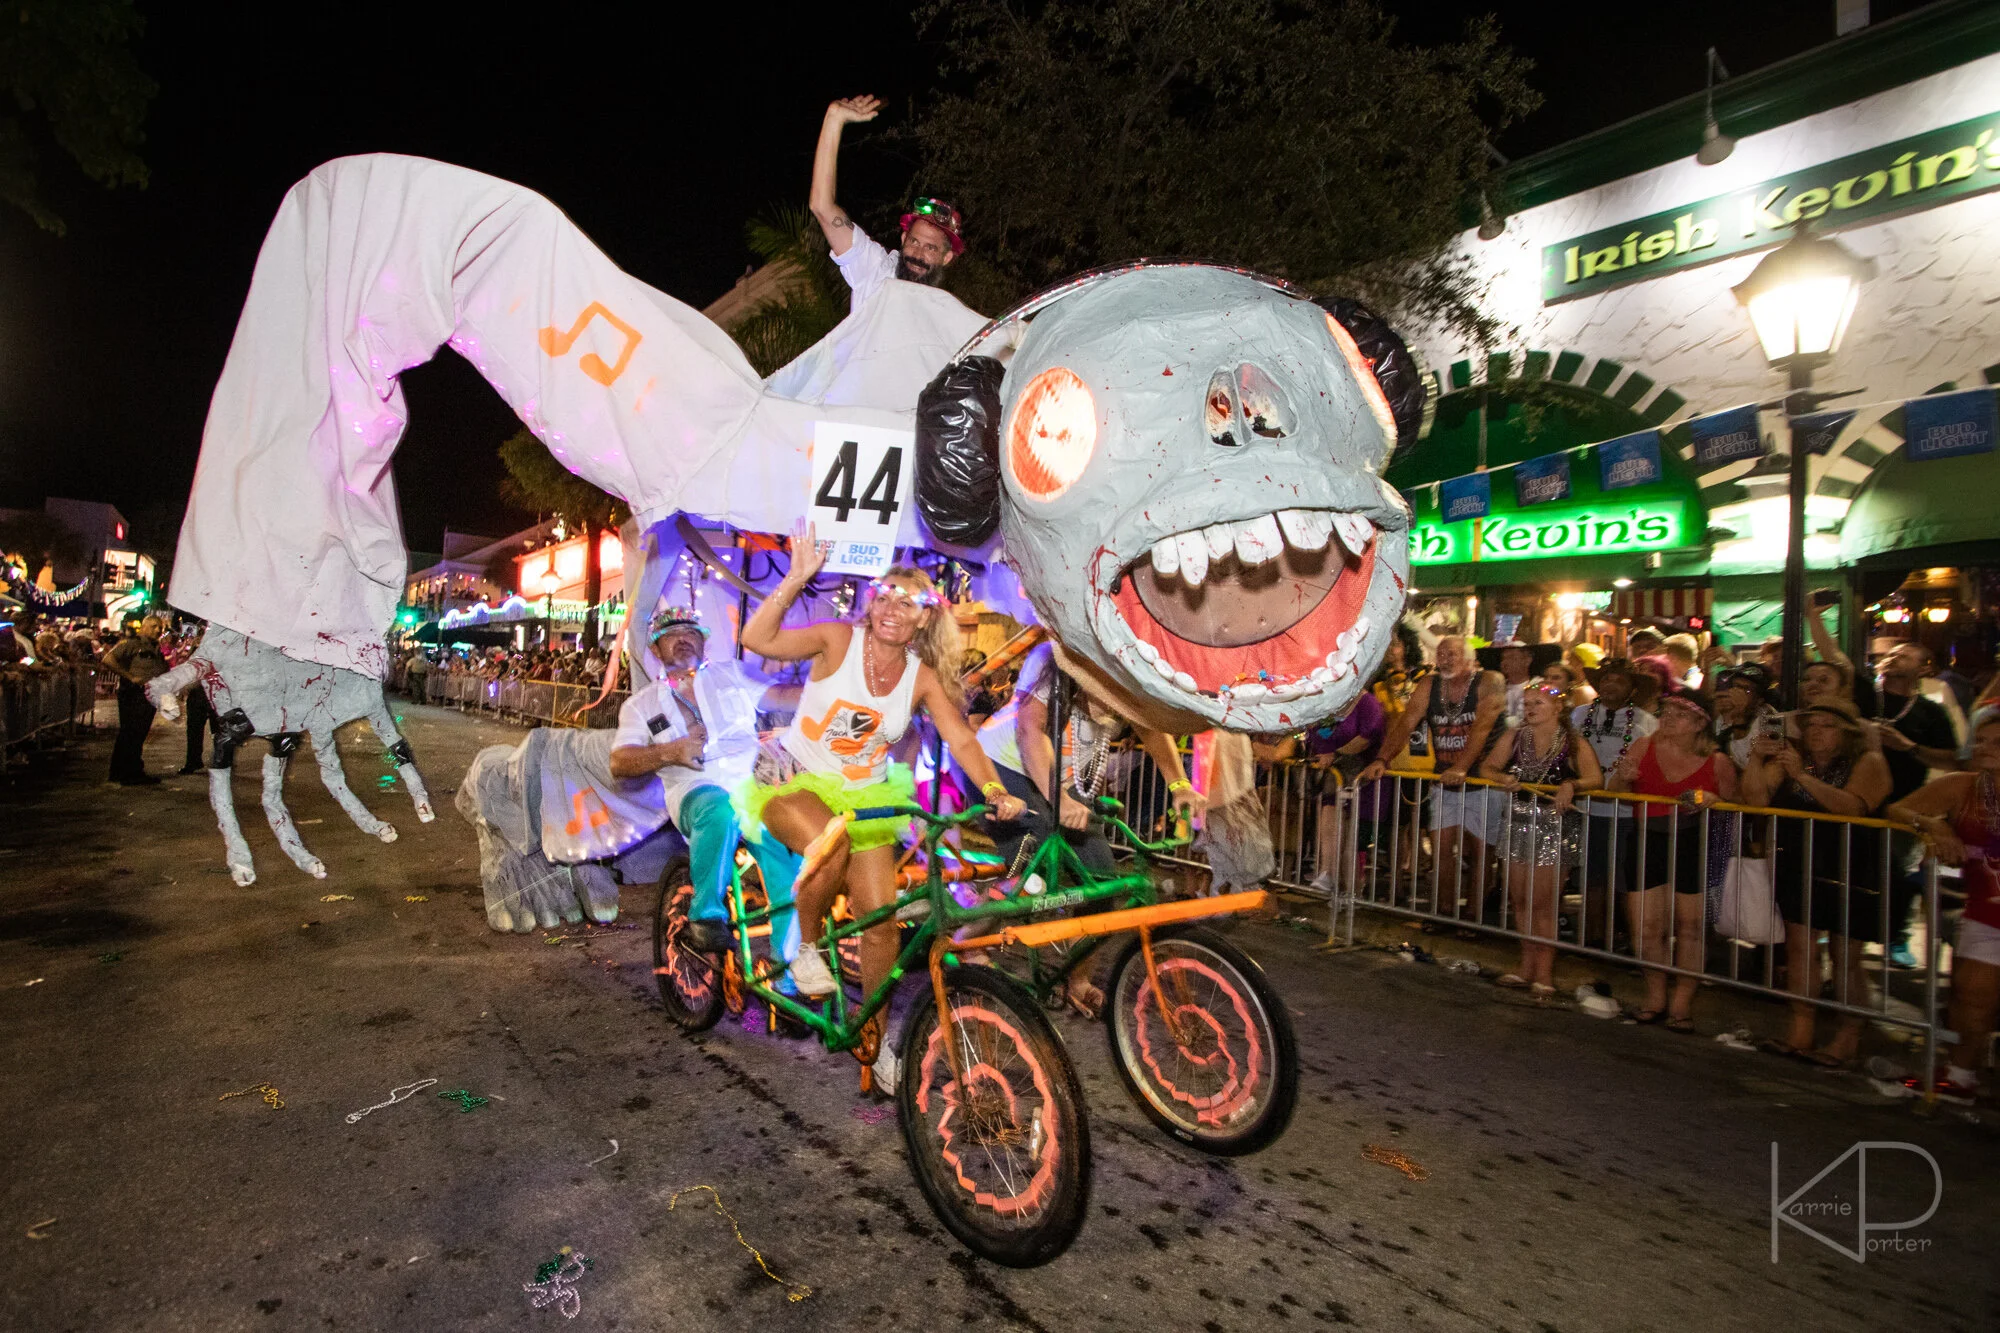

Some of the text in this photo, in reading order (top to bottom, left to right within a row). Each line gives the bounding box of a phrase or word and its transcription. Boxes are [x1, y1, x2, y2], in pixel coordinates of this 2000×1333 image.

[1564, 213, 1720, 284] Irish
[1928, 421, 1977, 439] BUD
[1710, 431, 1749, 447] BUD
[1920, 431, 1988, 451] LIGHT
[1704, 439, 1758, 459] LIGHT
[1612, 457, 1648, 473] BUD
[814, 441, 903, 525] 44
[1528, 474, 1560, 488] BUD
[1452, 495, 1480, 508] BUD
[1481, 508, 1669, 552] Kevin's
[848, 544, 879, 556] BUD
[840, 554, 884, 566] LIGHT
